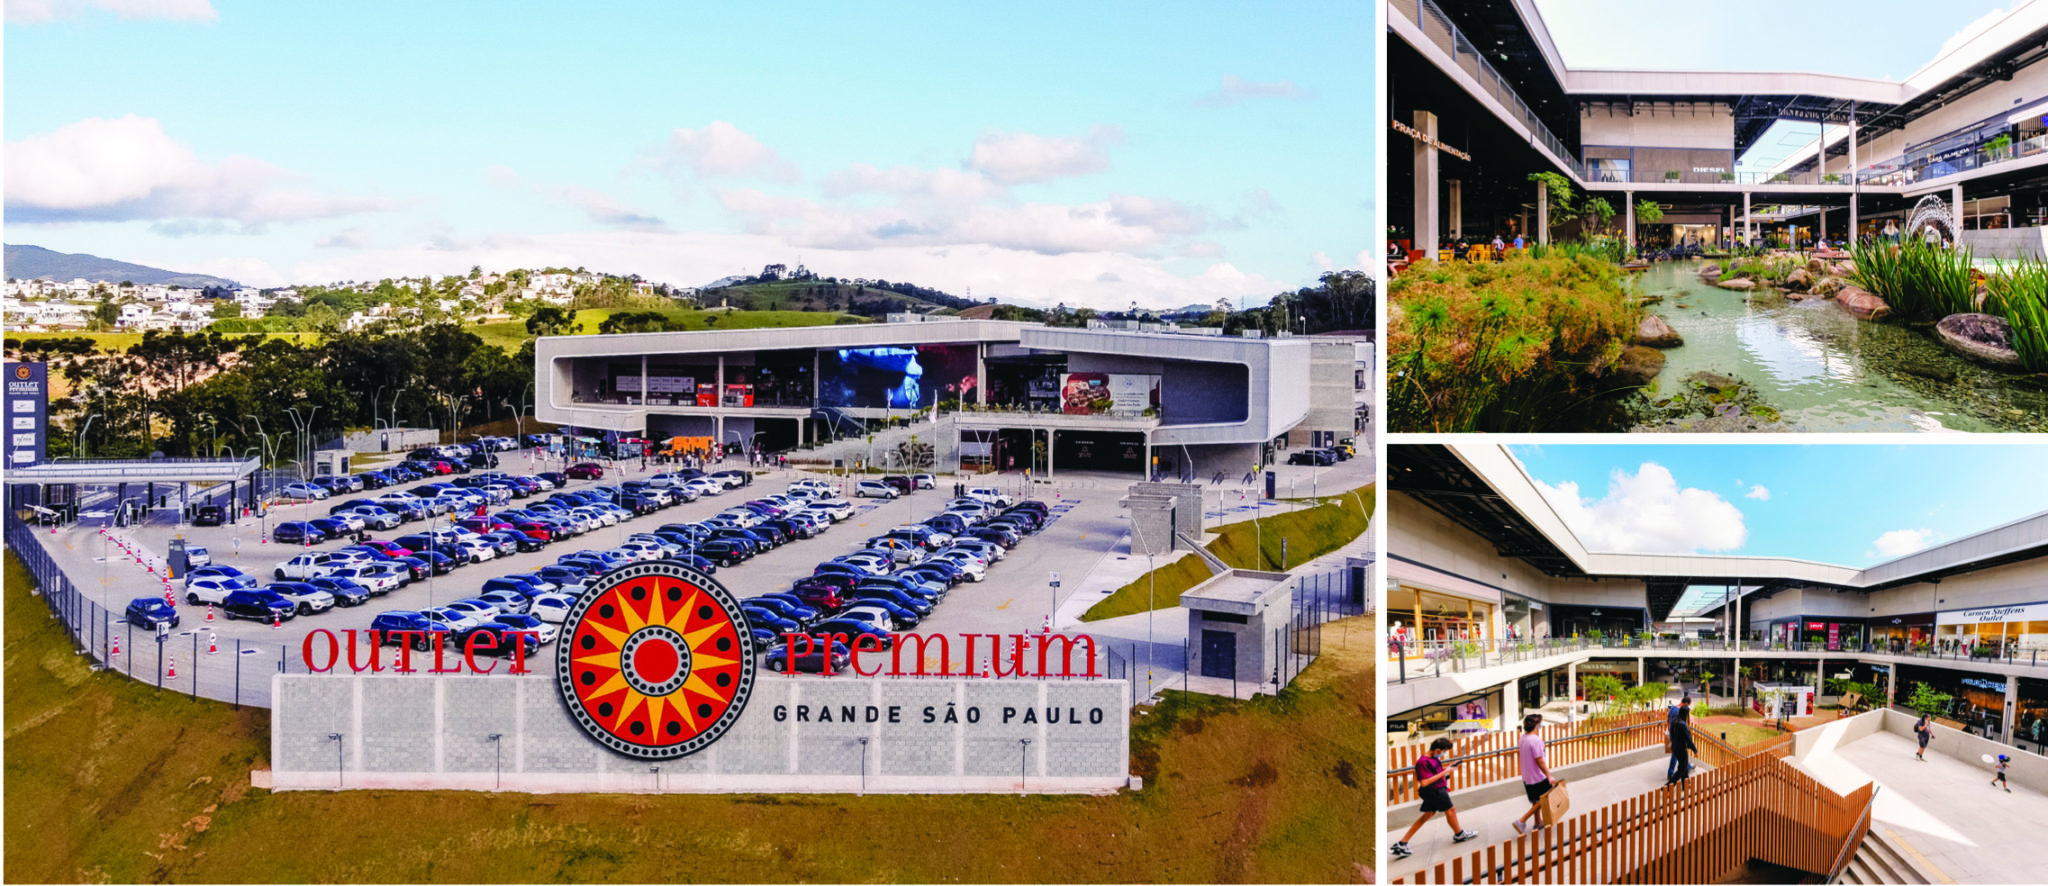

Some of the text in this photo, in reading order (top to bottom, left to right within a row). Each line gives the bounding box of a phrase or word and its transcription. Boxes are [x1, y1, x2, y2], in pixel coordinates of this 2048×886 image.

[1392, 120, 1421, 140] PRAÇA
[1421, 133, 1433, 145] DE
[1992, 607, 2025, 616] Steffens
[773, 701, 1104, 725] GRANDE SÃO PAULO
